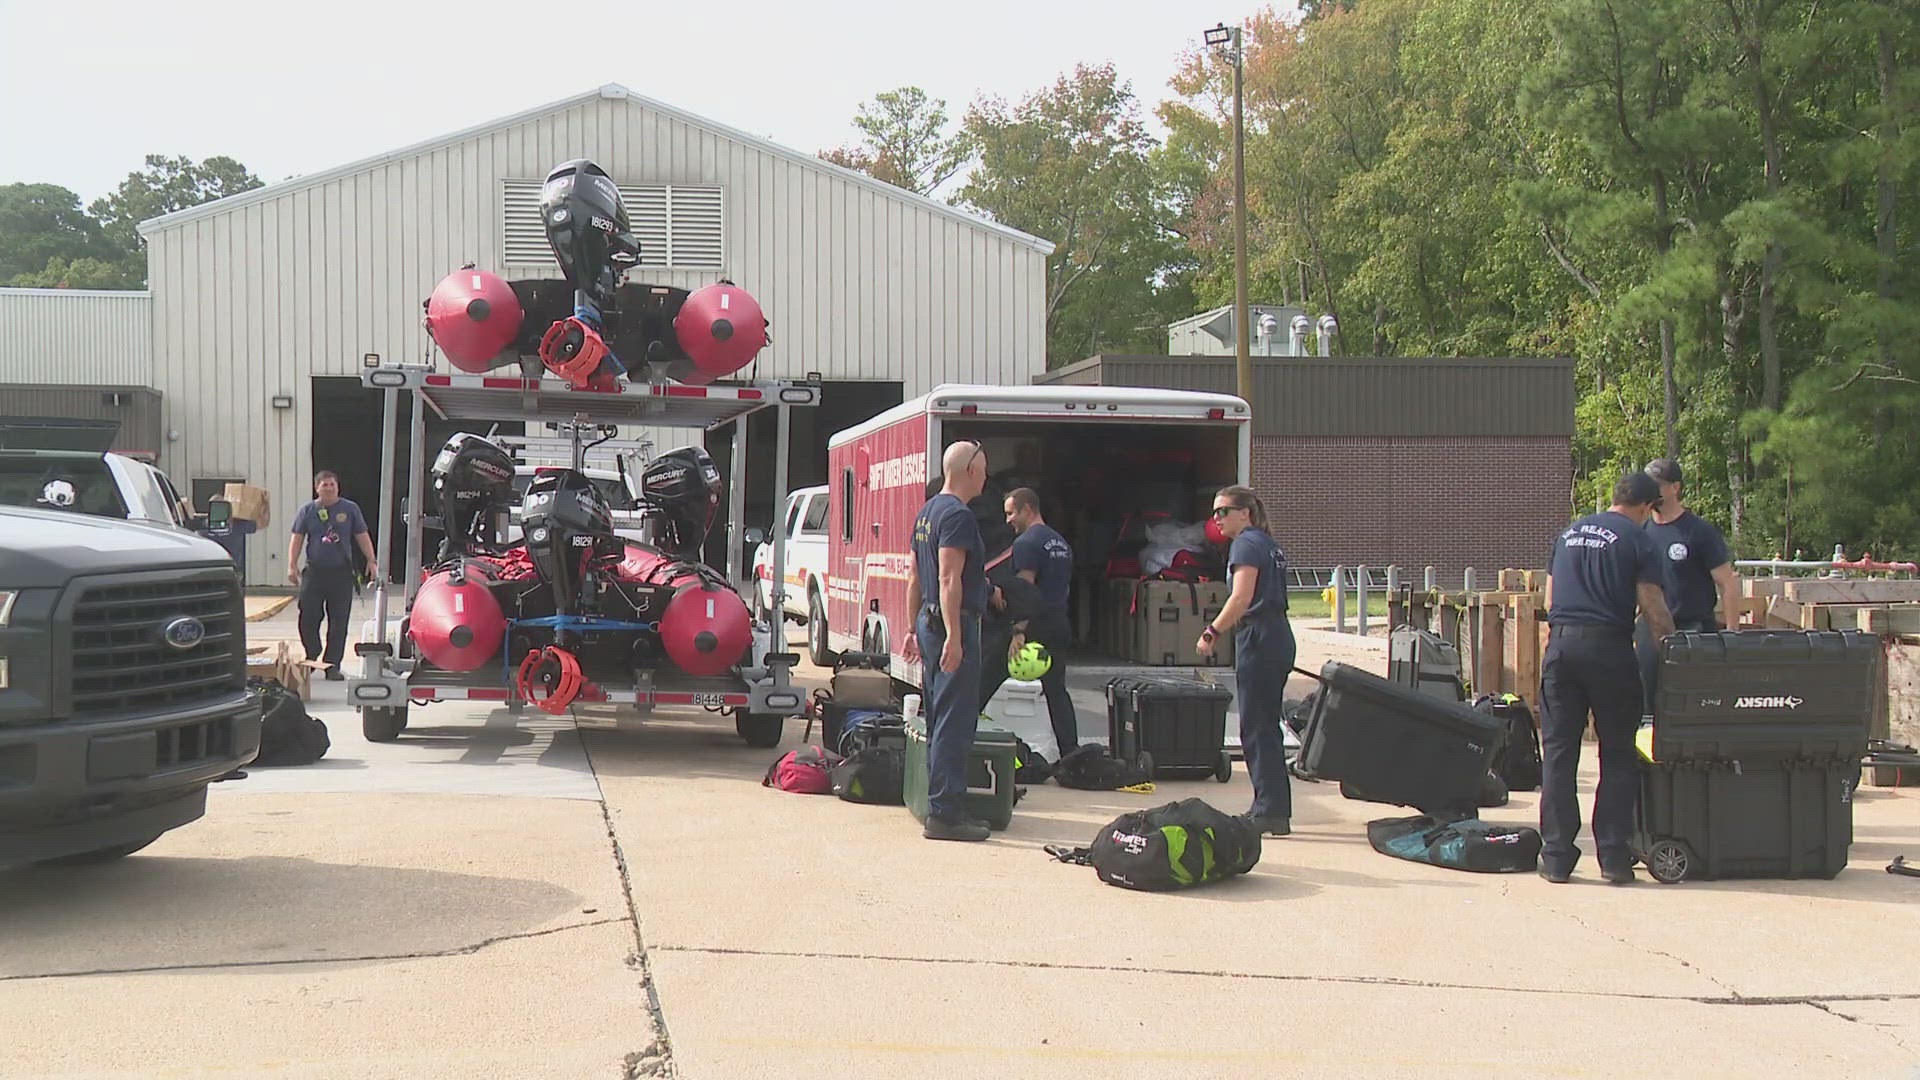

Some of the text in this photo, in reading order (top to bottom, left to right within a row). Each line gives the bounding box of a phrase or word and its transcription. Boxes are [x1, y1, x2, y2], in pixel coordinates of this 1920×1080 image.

[591, 215, 614, 232] 181293
[469, 457, 511, 478] MERCURY
[646, 468, 687, 485] MERCURY
[177, 624, 199, 641] Ford
[692, 693, 725, 704] 181448
[1734, 697, 1785, 708] HUSKY
[1112, 829, 1148, 848] mares
